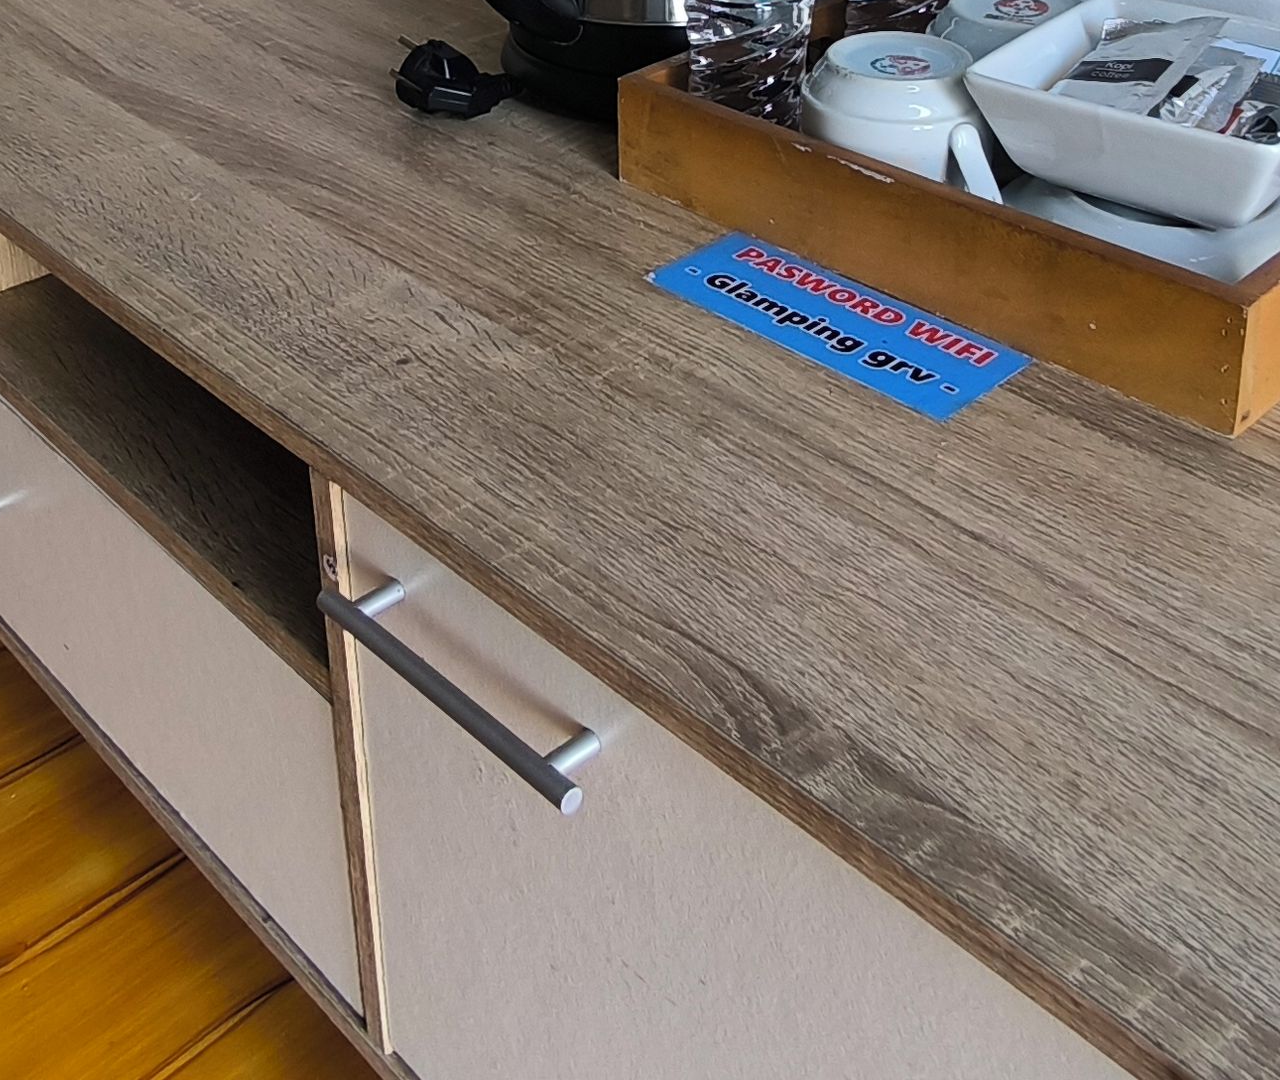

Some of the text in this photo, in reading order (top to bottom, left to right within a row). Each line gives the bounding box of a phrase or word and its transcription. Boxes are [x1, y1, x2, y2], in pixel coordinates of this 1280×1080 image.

[1091, 70, 1130, 79] coffee
[1104, 60, 1136, 70] Kopi
[704, 272, 867, 354] Glamping
[859, 350, 938, 385] grv
[733, 246, 999, 367] PASWORD WIFI
